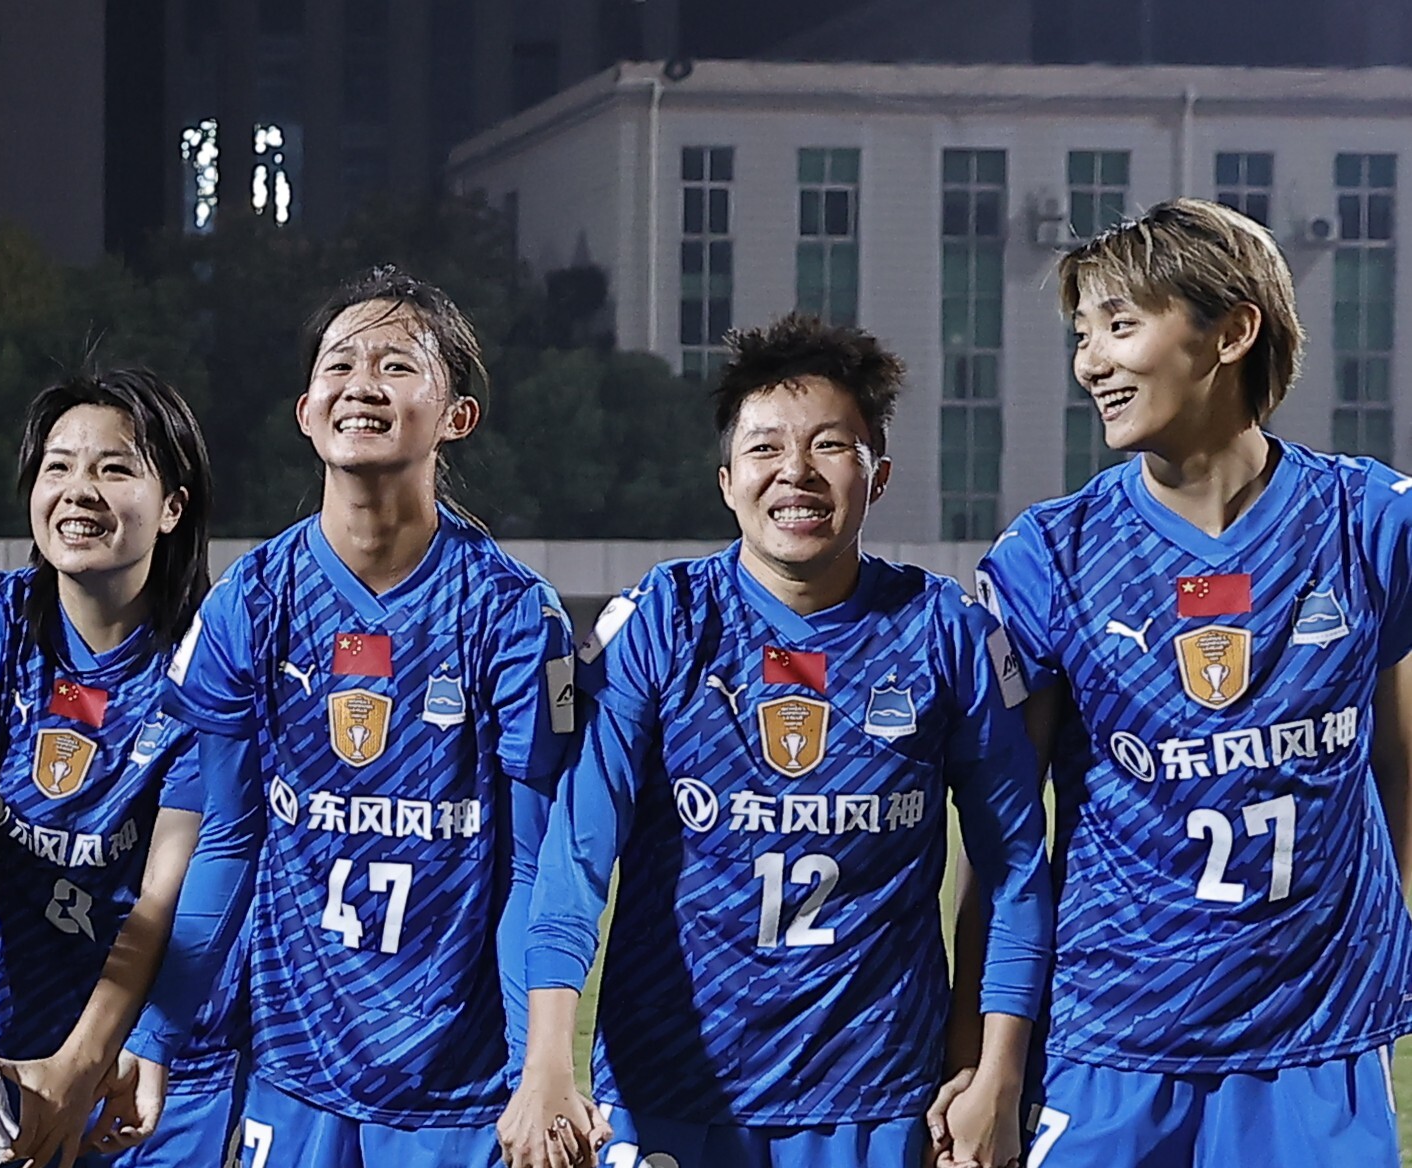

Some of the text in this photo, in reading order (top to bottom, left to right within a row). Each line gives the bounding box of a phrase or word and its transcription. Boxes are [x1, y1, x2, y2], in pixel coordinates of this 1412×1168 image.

[1157, 707, 1358, 780] 东风风神
[308, 790, 481, 841] 东风风神
[729, 790, 924, 836] 东风风神
[1187, 794, 1296, 902] 27
[320, 858, 414, 954] 47
[753, 853, 840, 948] 12
